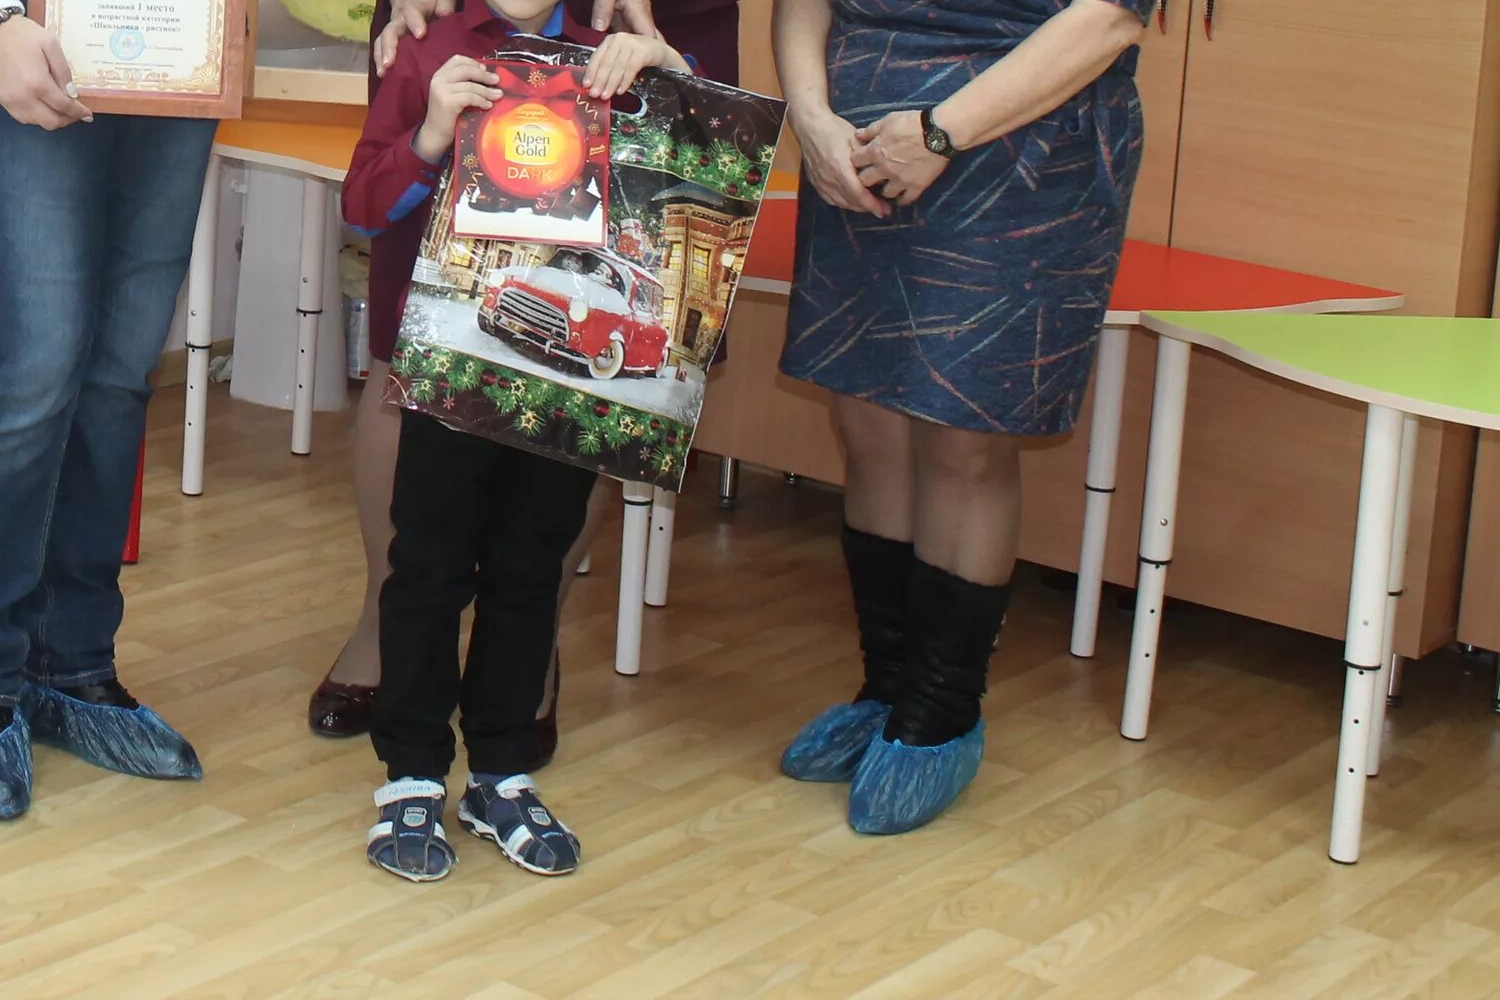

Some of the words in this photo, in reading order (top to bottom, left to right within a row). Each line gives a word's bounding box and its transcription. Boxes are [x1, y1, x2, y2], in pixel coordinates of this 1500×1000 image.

[146, 5, 175, 13] место
[513, 131, 550, 147] Alpen
[515, 145, 547, 158] Gold
[507, 166, 554, 181] DARK
